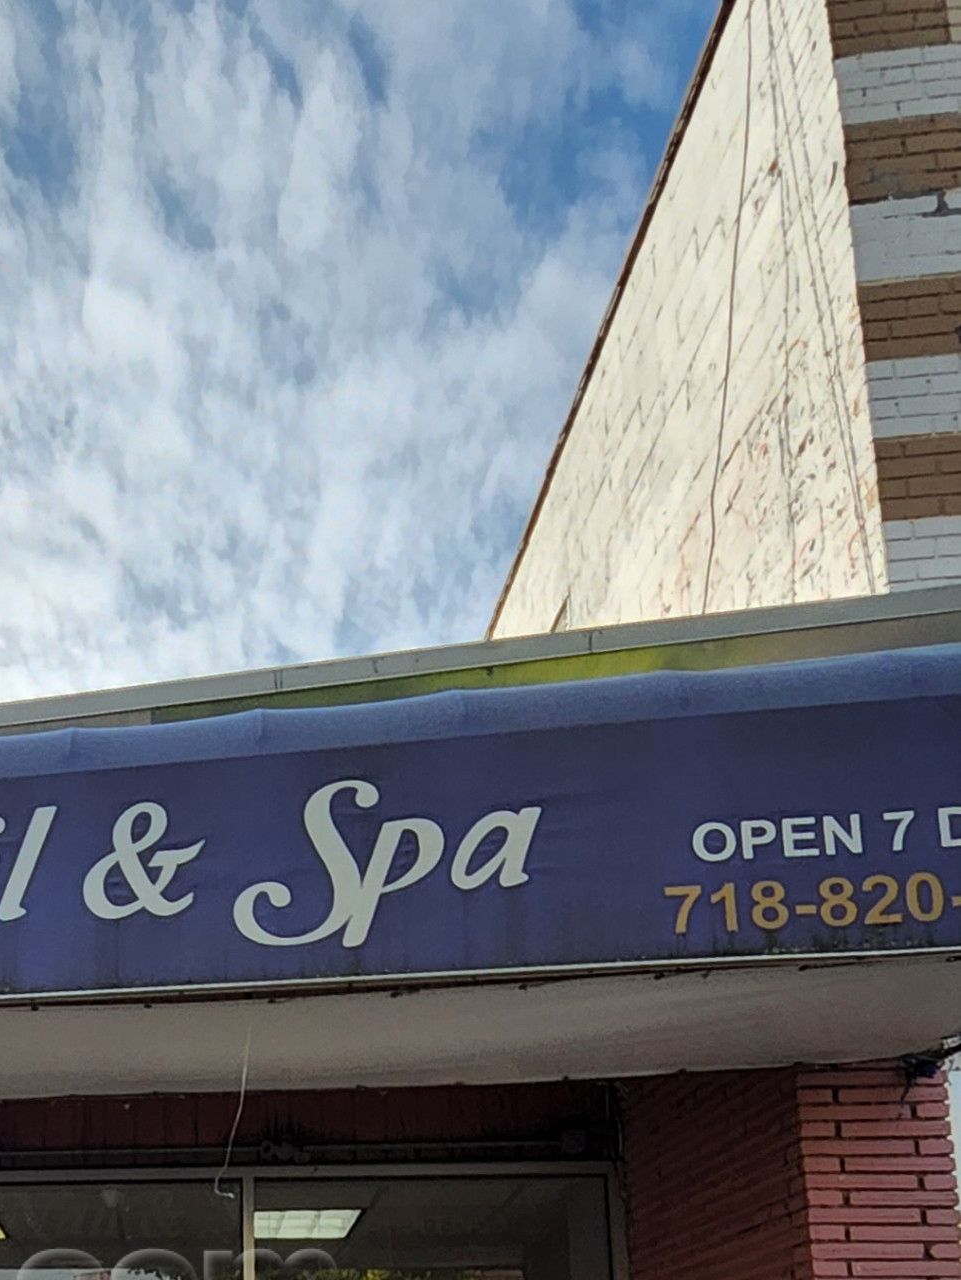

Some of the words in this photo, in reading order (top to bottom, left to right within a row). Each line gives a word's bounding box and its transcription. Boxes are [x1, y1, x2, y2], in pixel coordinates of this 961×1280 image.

[83, 802, 204, 919] &
[233, 780, 541, 947] Spa
[692, 813, 863, 862] OPEN
[883, 810, 915, 851] 7
